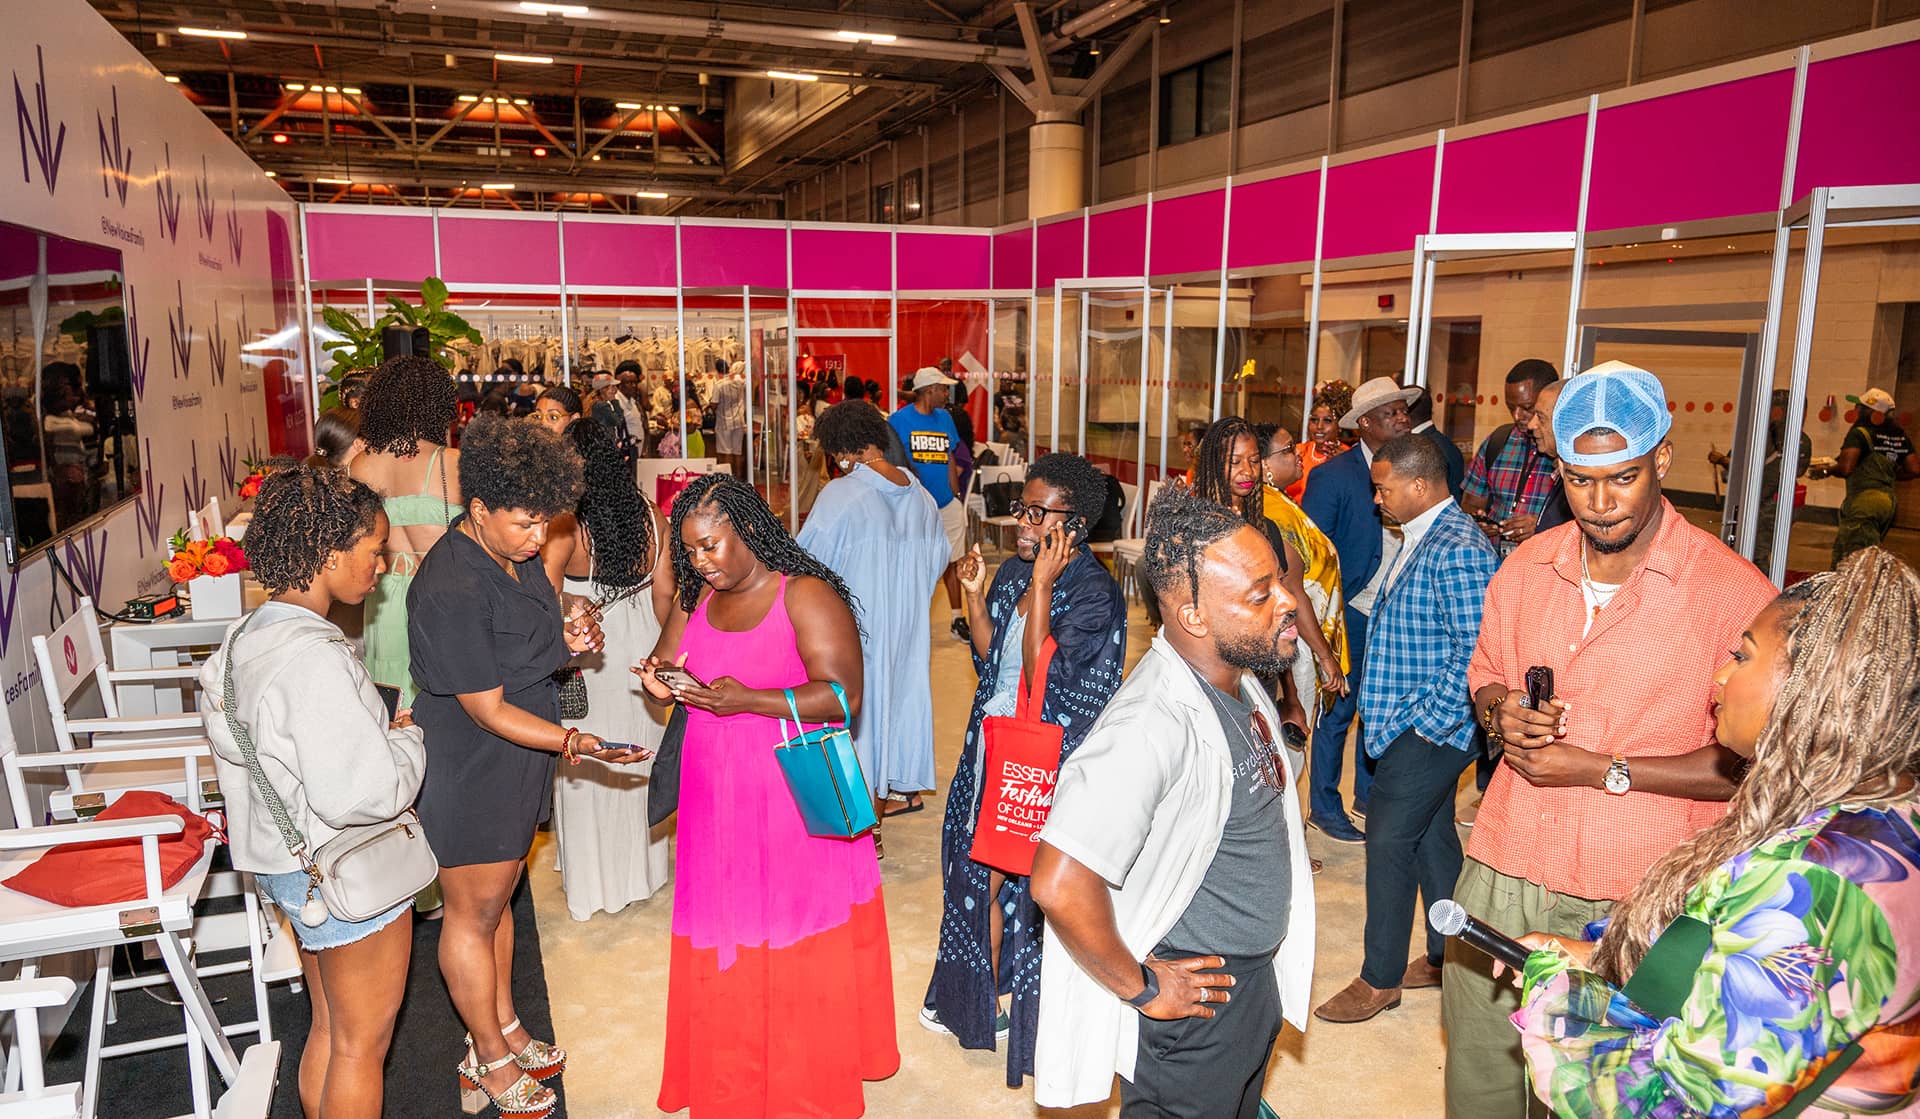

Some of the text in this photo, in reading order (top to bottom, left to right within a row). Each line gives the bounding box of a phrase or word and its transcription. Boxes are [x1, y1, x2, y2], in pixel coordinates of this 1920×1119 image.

[1002, 761, 1058, 785] ESSENC
[1000, 779, 1053, 807] Festiva
[997, 802, 1047, 823] OF CULTU
